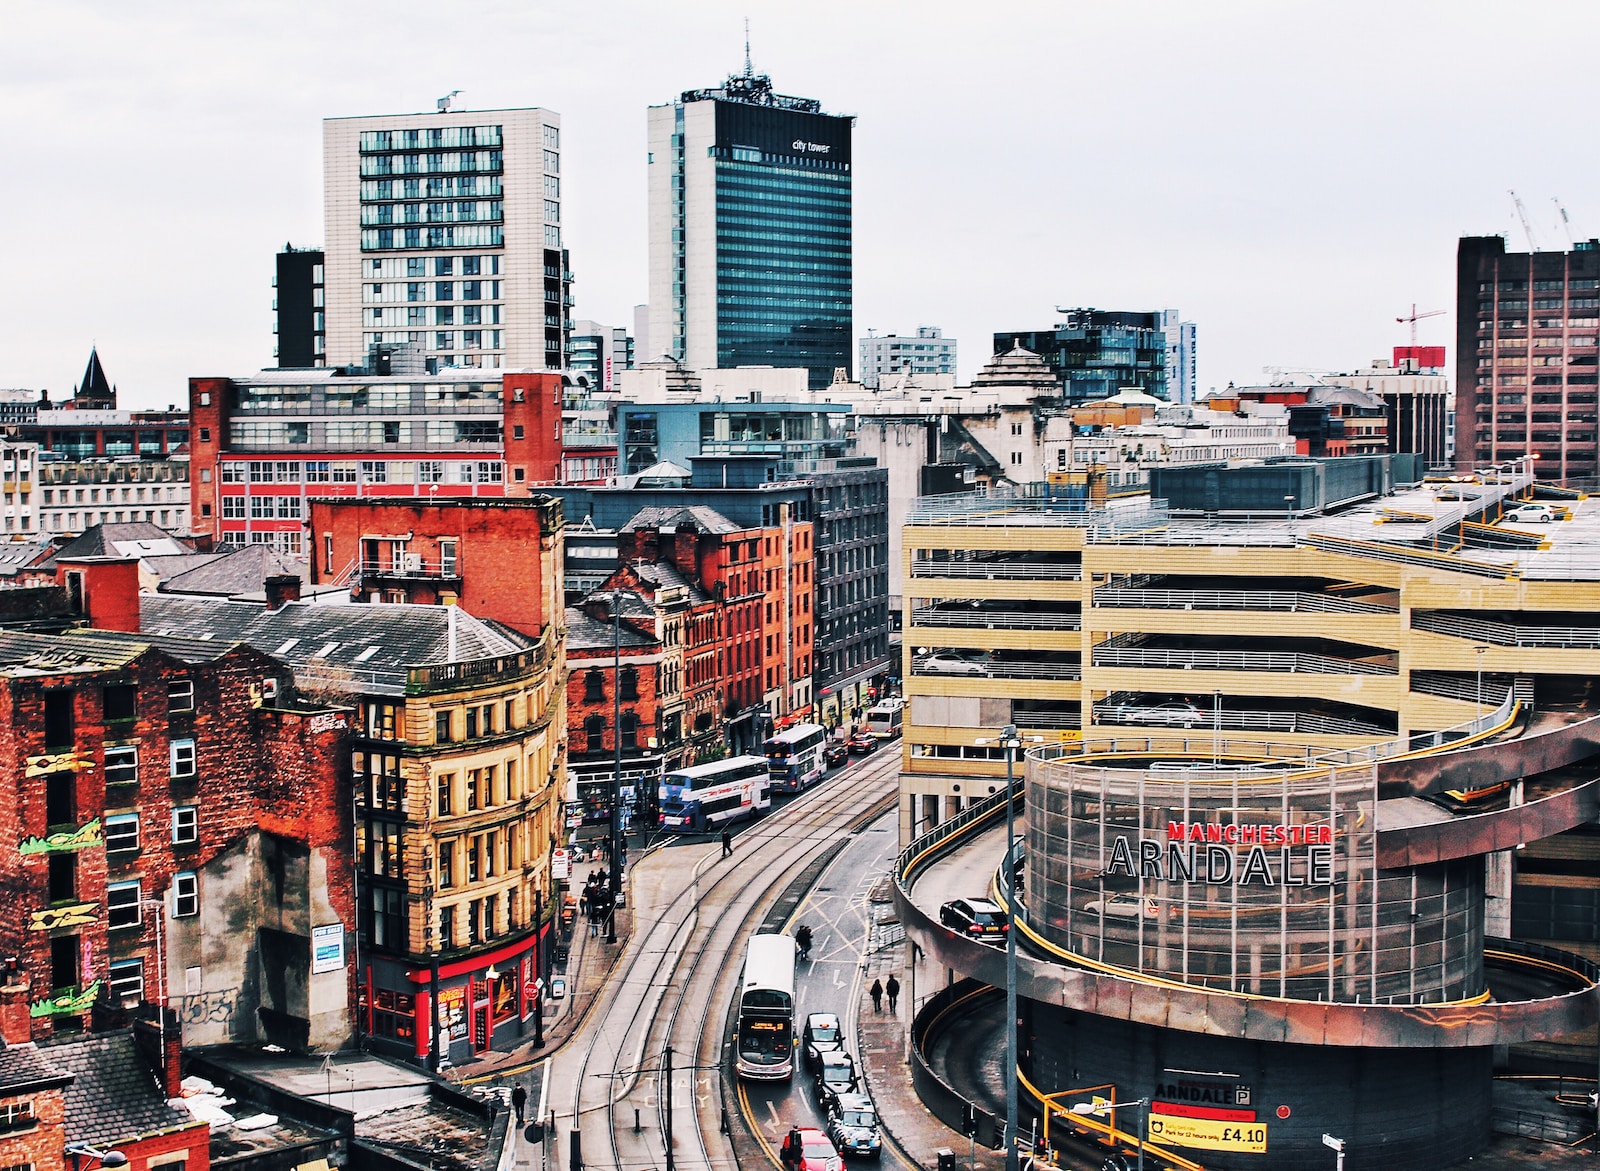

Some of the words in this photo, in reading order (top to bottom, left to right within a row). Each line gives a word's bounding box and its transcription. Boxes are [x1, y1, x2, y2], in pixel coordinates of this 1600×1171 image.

[792, 140, 807, 153] city
[808, 142, 830, 154] tower
[1168, 821, 1331, 845] MANCHESTER
[1107, 835, 1331, 887] ARNDALE
[1155, 1083, 1233, 1105] ARNDALE
[1222, 1128, 1265, 1143] £4.10
